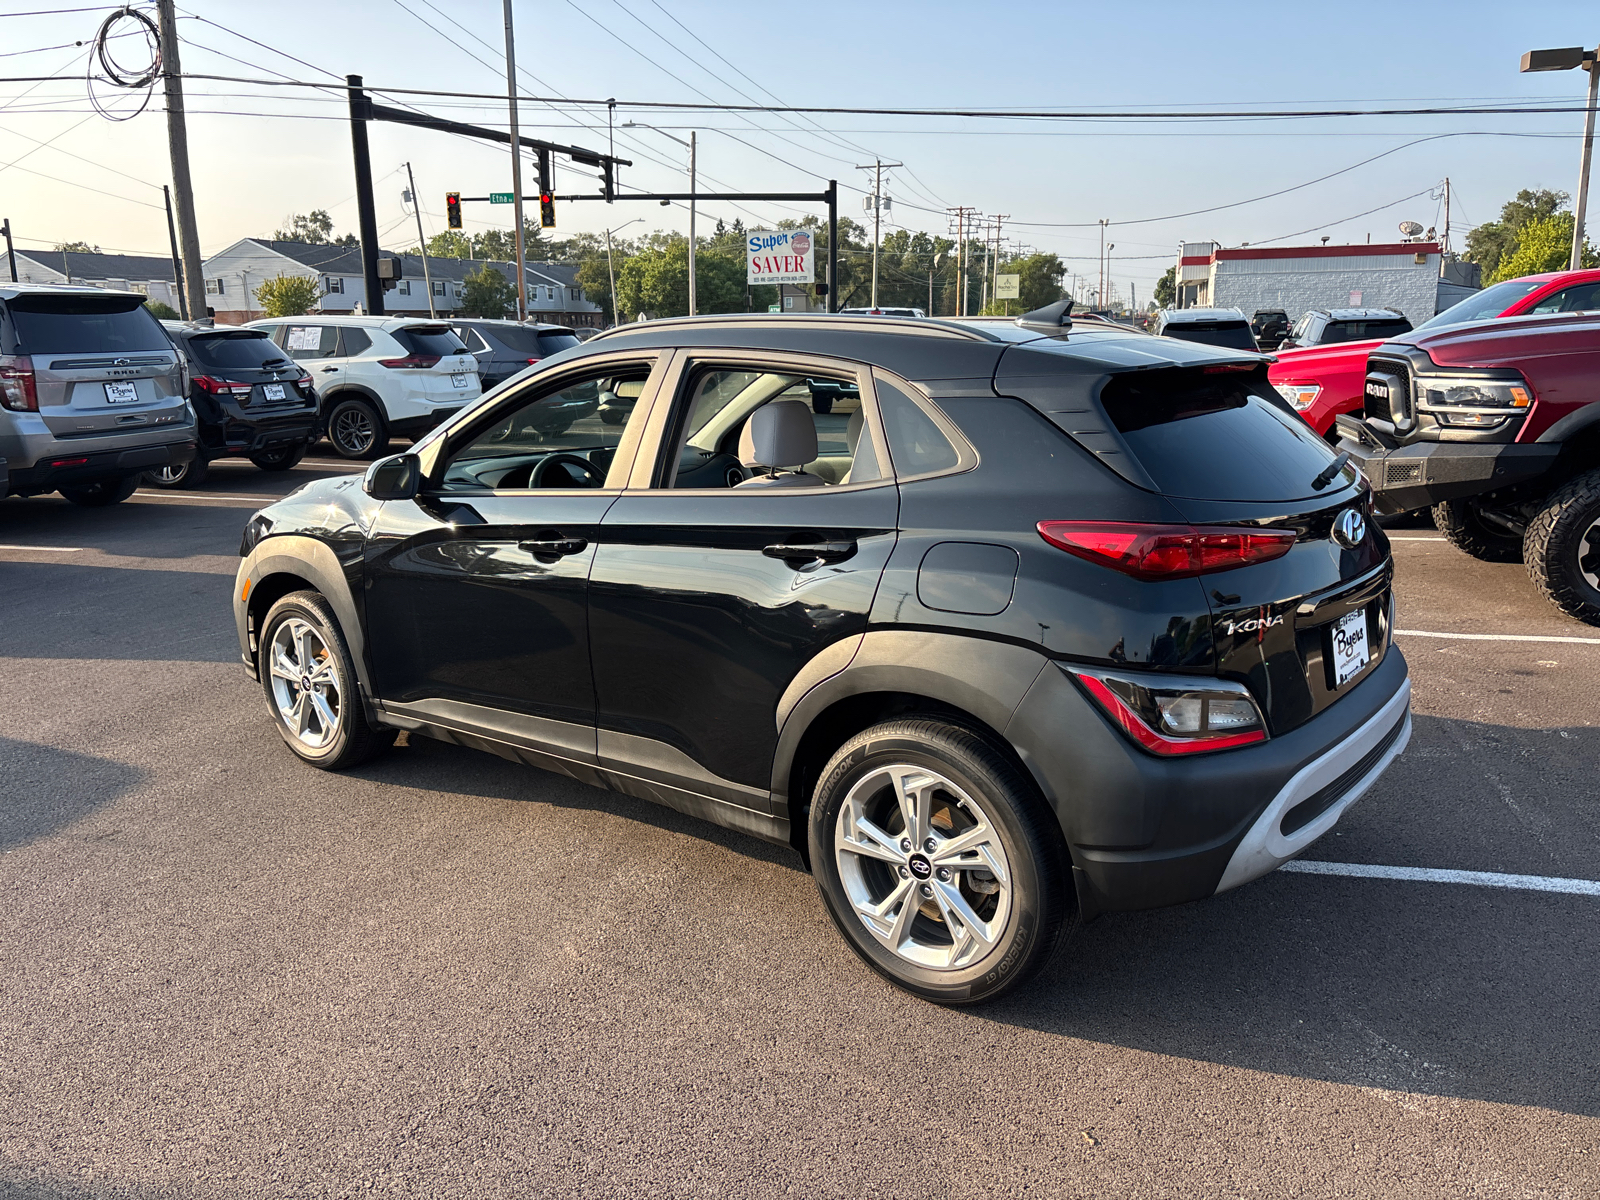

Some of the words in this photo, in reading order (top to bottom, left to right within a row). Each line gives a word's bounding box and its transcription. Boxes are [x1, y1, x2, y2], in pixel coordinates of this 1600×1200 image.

[492, 194, 507, 203] Etna
[749, 233, 788, 252] Super
[752, 255, 805, 274] SAVER
[108, 386, 133, 397] Byers
[1366, 383, 1388, 398] RAM
[1227, 614, 1284, 635] KONA
[1333, 627, 1364, 658] Byers
